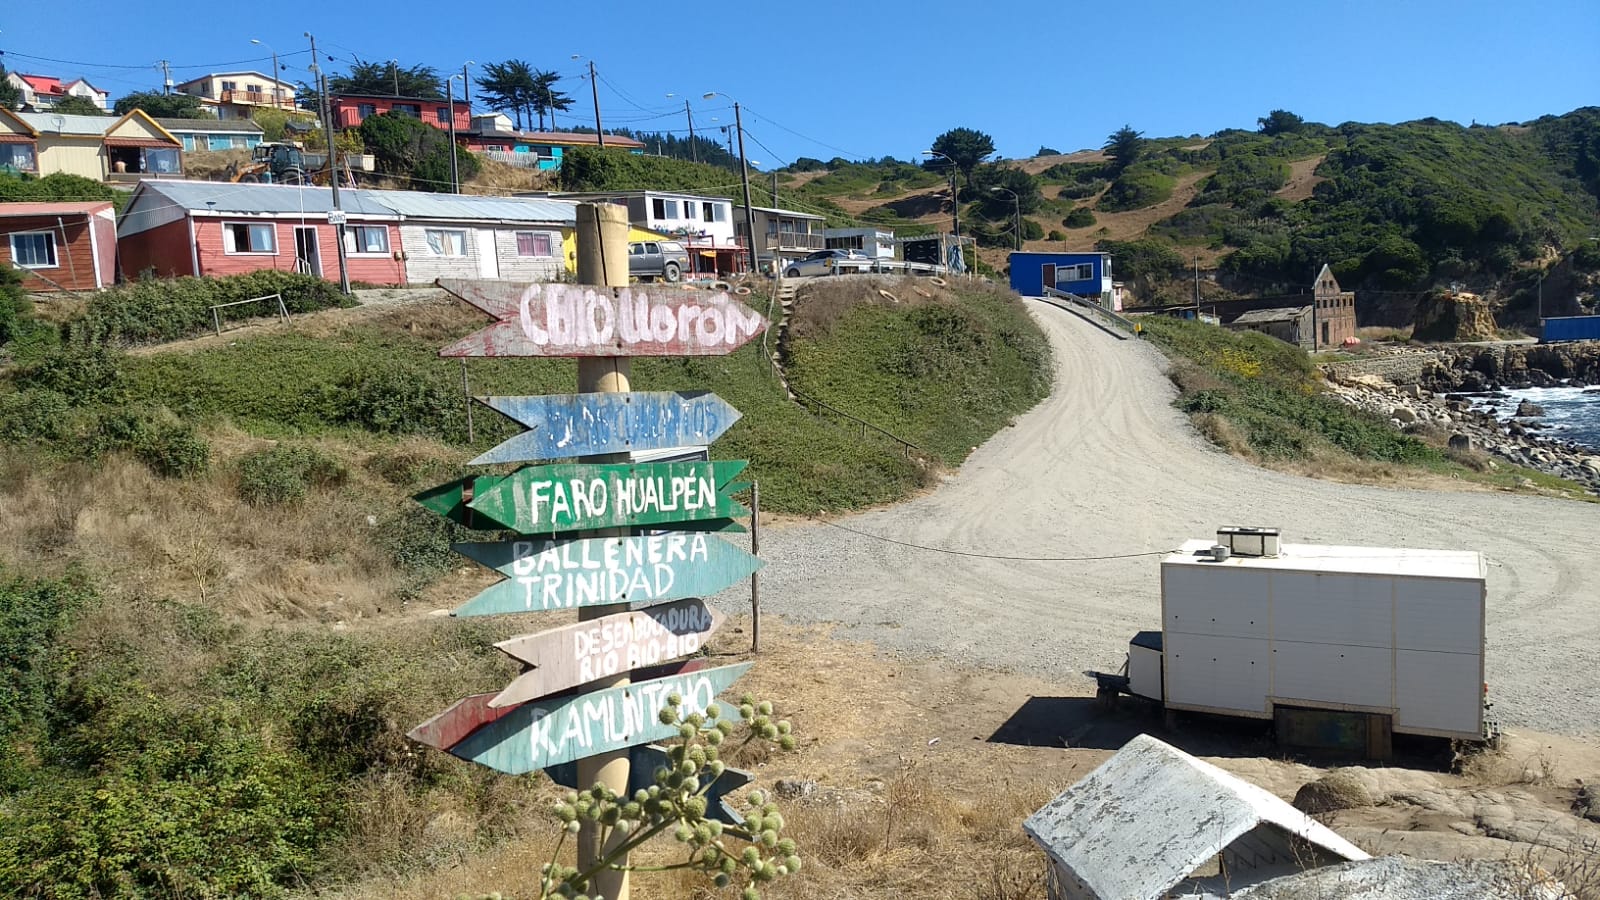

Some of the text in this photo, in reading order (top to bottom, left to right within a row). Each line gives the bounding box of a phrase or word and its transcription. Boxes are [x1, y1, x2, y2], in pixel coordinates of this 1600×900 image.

[530, 467, 716, 524] FARO HUALPÉN
[513, 534, 708, 576] BALLENERA
[517, 563, 675, 608] TRINIDAD
[580, 631, 698, 683] RIO BIO-BIO
